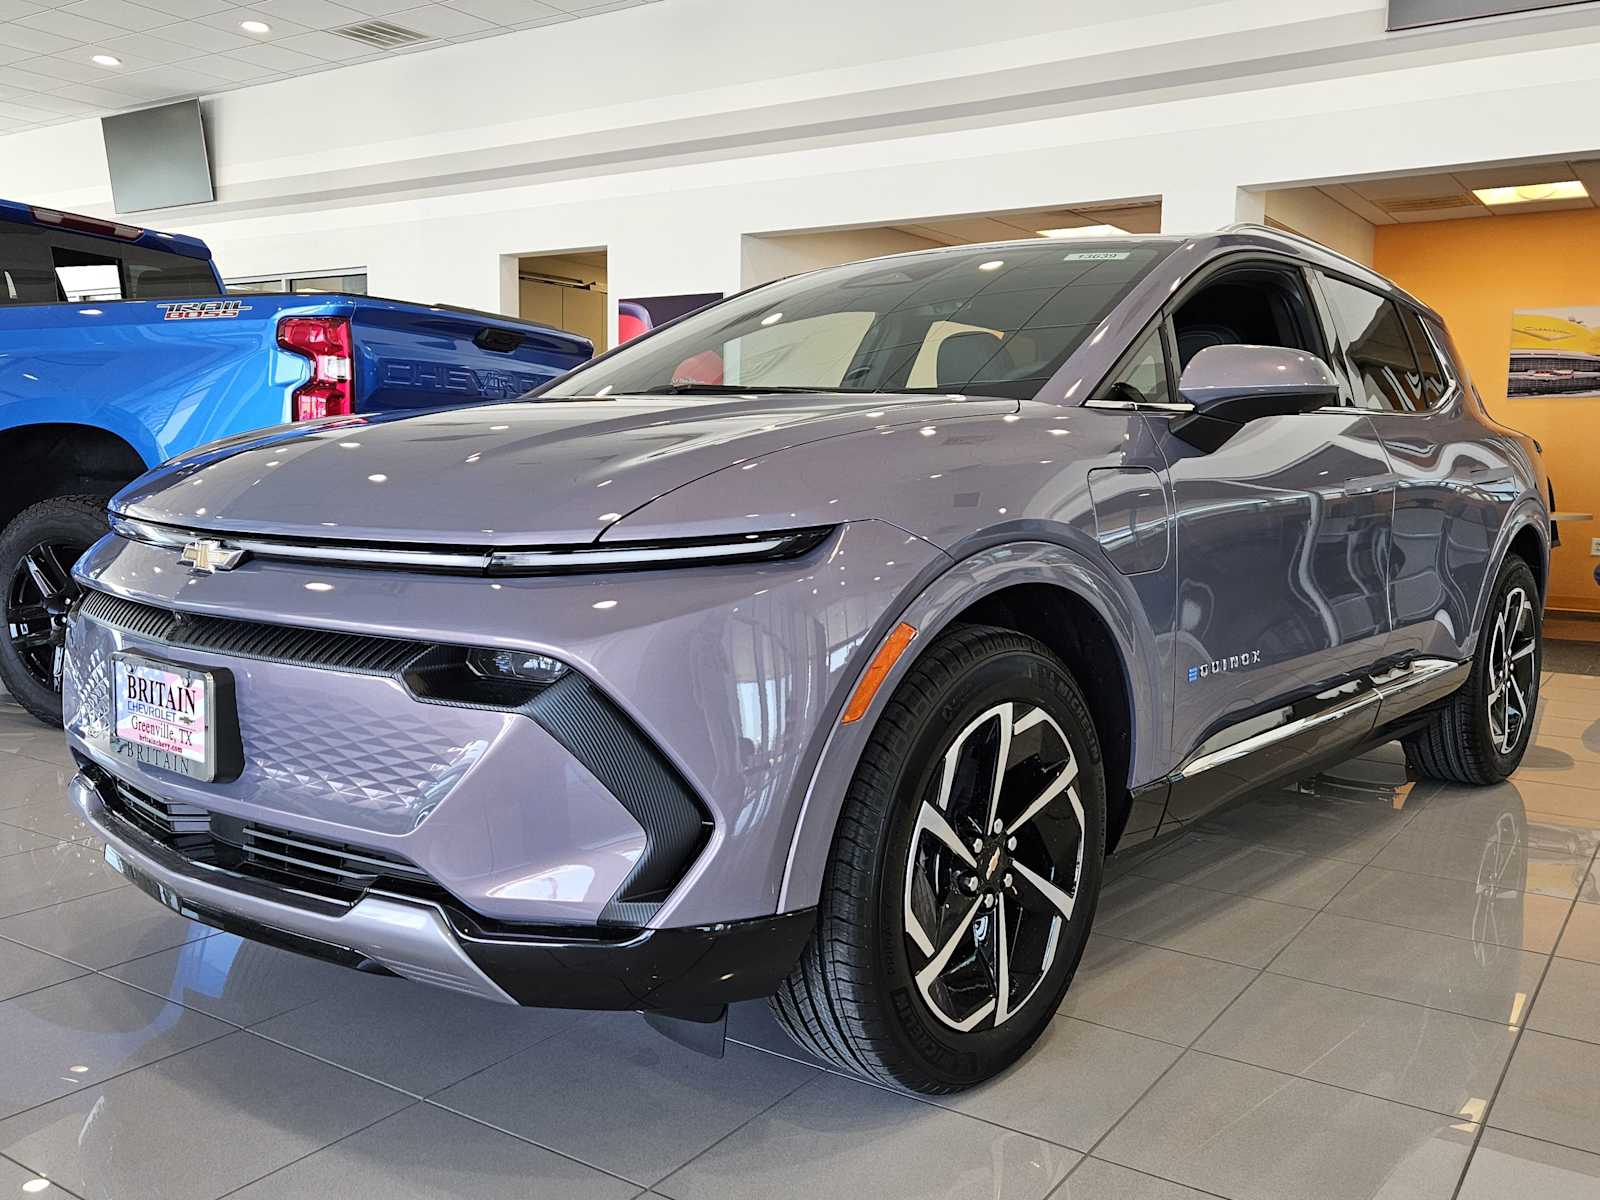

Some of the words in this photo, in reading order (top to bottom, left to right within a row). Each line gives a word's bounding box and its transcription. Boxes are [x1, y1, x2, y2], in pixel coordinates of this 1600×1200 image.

[156, 300, 253, 313] TRAIL
[164, 310, 240, 320] BOSS
[1187, 650, 1261, 682] EQUINOX
[127, 675, 196, 716] BRITAIN
[127, 700, 176, 722] CHEVROLET
[131, 715, 177, 744] Greenville,
[179, 728, 193, 746] TX
[127, 742, 190, 774] BRITAIN
